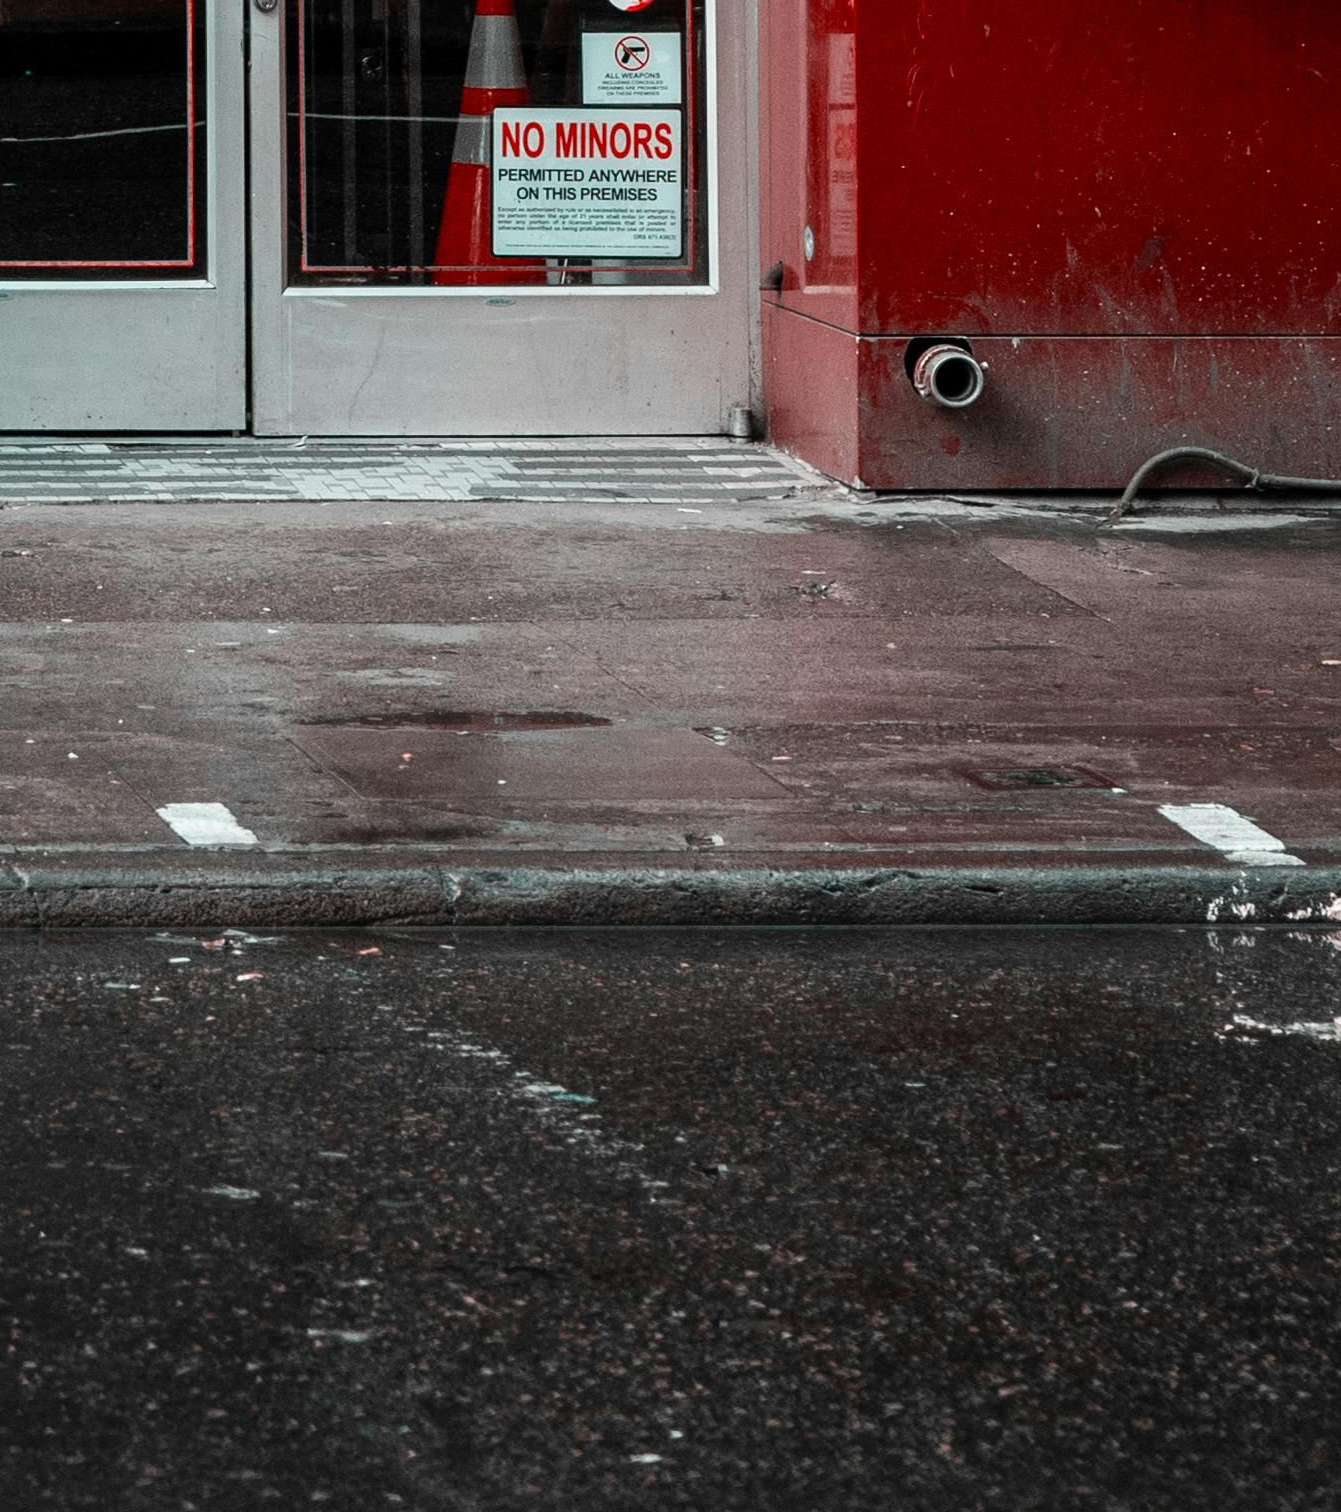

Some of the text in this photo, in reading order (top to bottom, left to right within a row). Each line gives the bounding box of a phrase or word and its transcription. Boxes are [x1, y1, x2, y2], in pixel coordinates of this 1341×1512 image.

[501, 120, 674, 160] NO MINORS
[498, 168, 678, 183] PERMITTED ANYWHERE
[517, 187, 658, 201] ON THIS PREMISES
